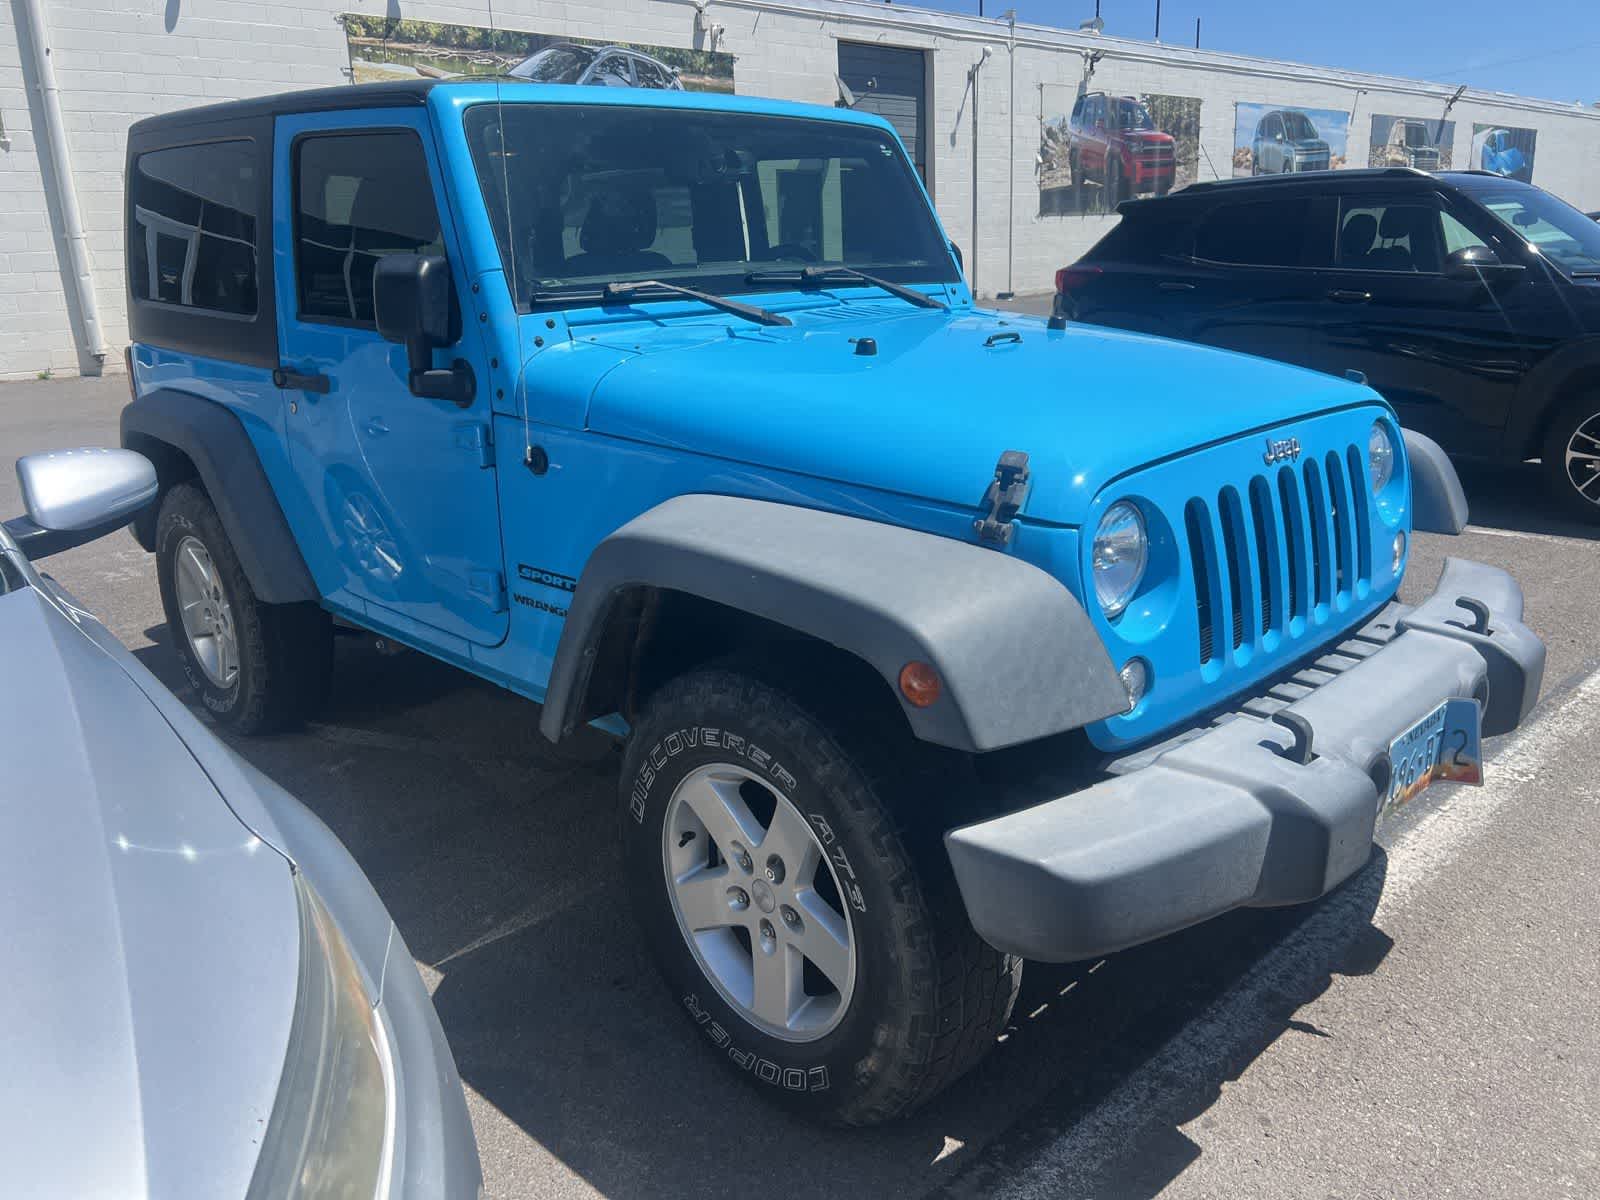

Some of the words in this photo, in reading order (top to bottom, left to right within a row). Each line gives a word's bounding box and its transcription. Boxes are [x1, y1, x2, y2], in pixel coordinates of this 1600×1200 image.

[1264, 438, 1301, 466] Jeep
[519, 566, 576, 591] SPORT
[630, 727, 797, 824] DISCOVERER
[683, 993, 830, 1092] COOPER
